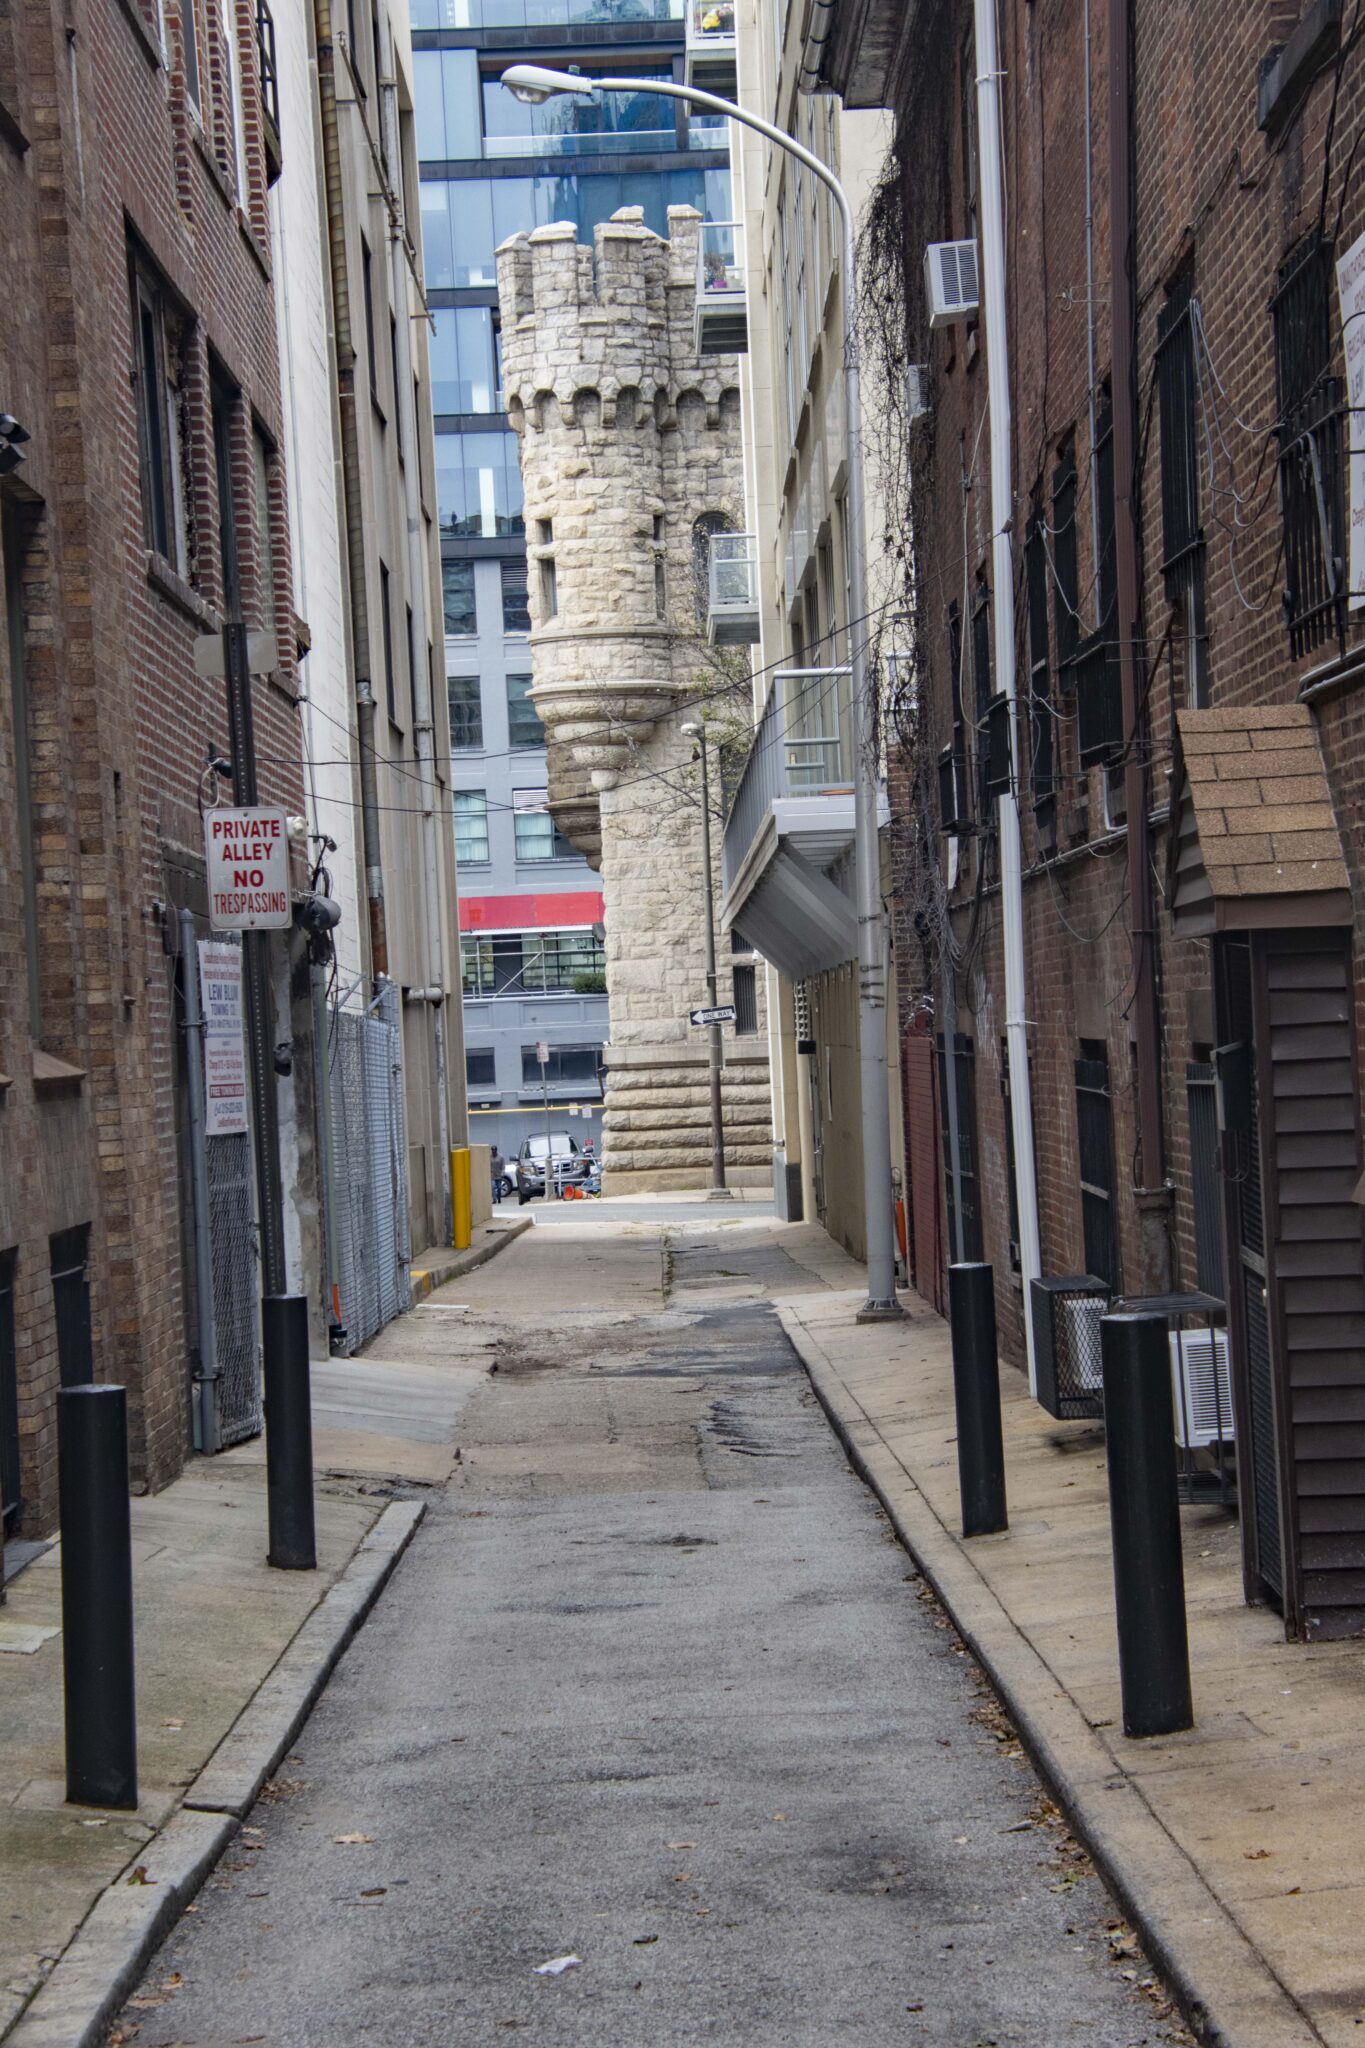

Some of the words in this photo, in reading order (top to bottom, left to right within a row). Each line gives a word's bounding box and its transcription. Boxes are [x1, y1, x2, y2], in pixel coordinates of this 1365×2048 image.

[212, 820, 280, 839] PRIVATE
[222, 843, 273, 861] ALLEY
[233, 869, 264, 887] NO
[213, 892, 287, 914] TRESPASSING
[208, 984, 222, 1001] LEW
